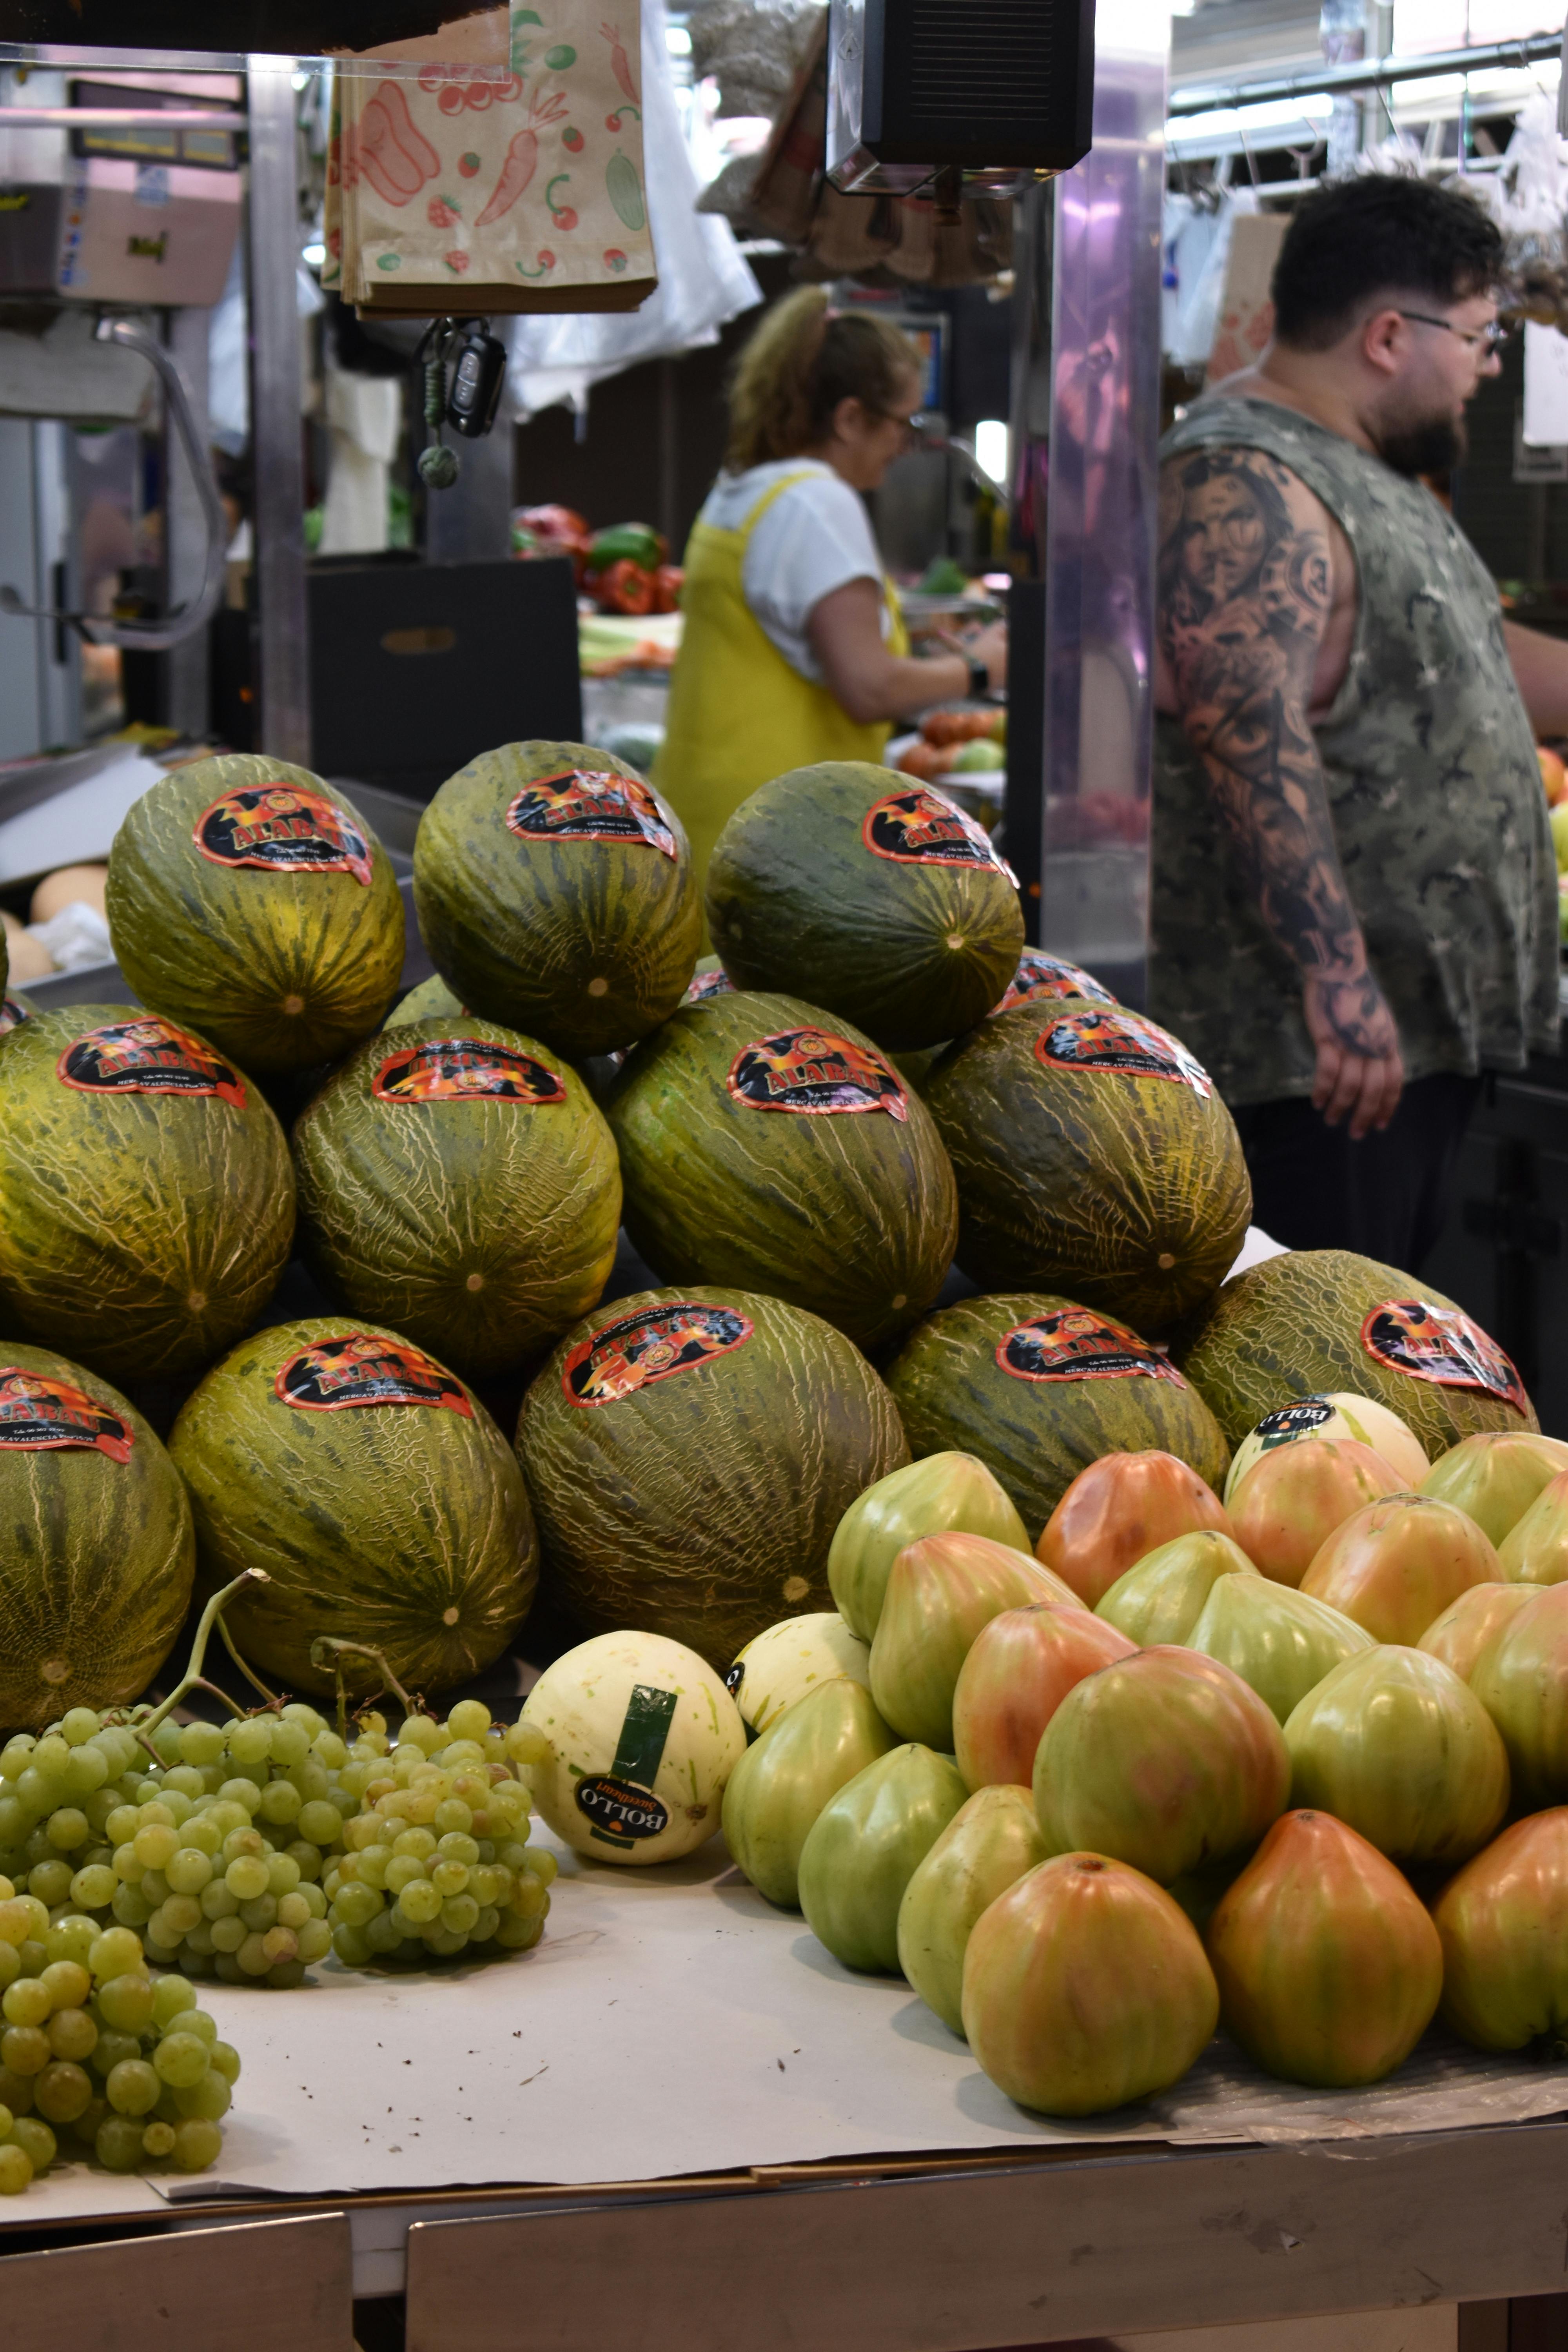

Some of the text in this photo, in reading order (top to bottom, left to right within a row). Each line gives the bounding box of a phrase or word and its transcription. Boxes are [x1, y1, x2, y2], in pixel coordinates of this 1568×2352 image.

[544, 799, 637, 826] ALABA
[96, 1050, 218, 1080] ALABAU
[765, 1062, 881, 1095] ALABAU
[590, 1313, 709, 1370] ALABAU
[316, 1361, 443, 1395] ALABAU
[1065, 1365, 1129, 1374] MERCAVALENCIA
[581, 1789, 664, 1830] BOLLO
[596, 1781, 657, 1812] Sweetheart
